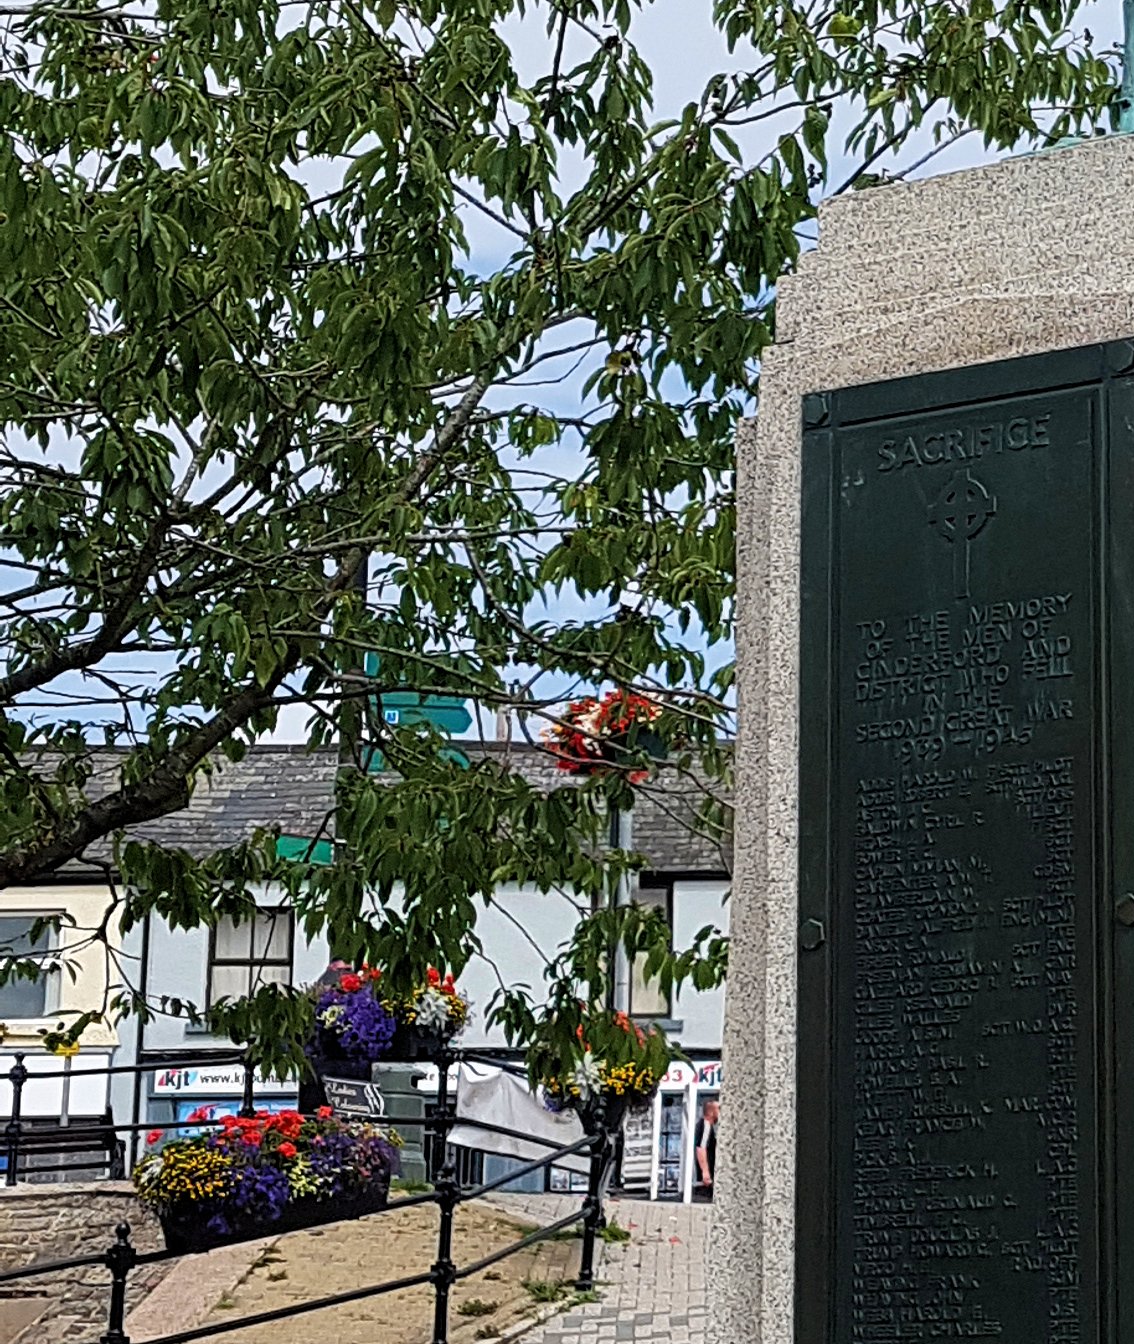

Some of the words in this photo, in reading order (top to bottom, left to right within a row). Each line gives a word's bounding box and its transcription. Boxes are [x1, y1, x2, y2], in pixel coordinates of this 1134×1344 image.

[877, 412, 1051, 472] SACRIFICE
[856, 620, 887, 640] TO
[905, 610, 951, 634] THE
[969, 592, 1073, 626] MEMORY
[866, 638, 894, 659] OF
[905, 630, 951, 653] THE
[962, 621, 1013, 647] MEN
[1021, 619, 1053, 640] OF
[856, 644, 1000, 681] CINDERFORD
[1022, 635, 1072, 658] AND
[856, 674, 951, 703] DISTRICT
[963, 664, 1010, 687] WHO
[1021, 657, 1074, 680] FELL
[856, 716, 937, 744] SECOND
[943, 704, 1014, 733] GREAT
[1028, 698, 1073, 721] WAR
[923, 692, 946, 713] IN
[955, 686, 1001, 708] THE
